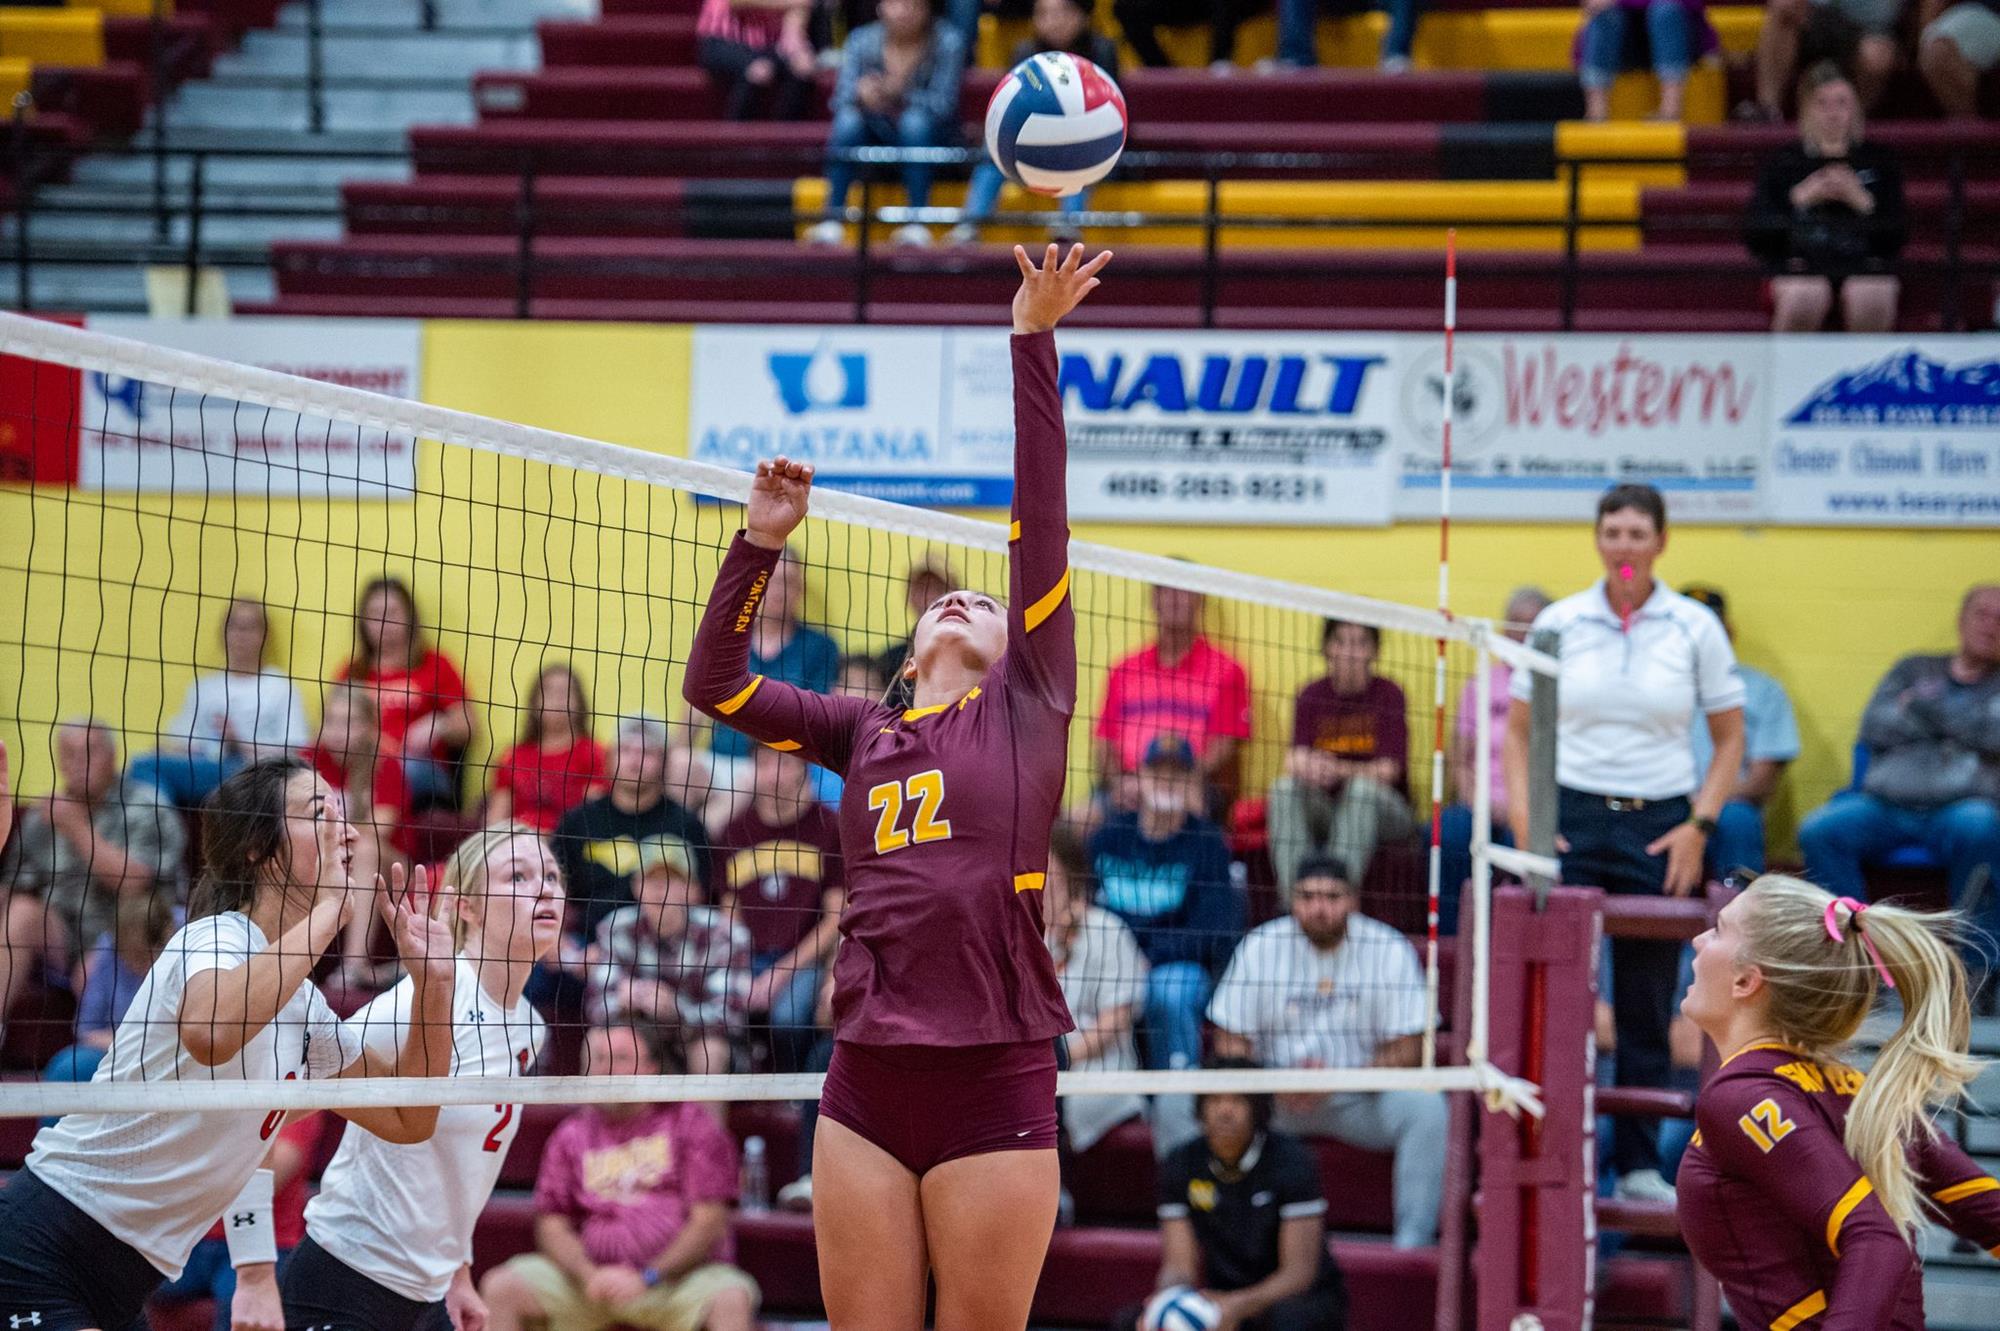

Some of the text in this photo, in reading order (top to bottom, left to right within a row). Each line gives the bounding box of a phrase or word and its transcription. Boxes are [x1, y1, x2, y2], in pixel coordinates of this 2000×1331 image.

[1503, 338, 1756, 436] Western
[698, 426, 931, 461] AQUATANA
[868, 769, 952, 855] 22
[1738, 1098, 1798, 1154] 12
